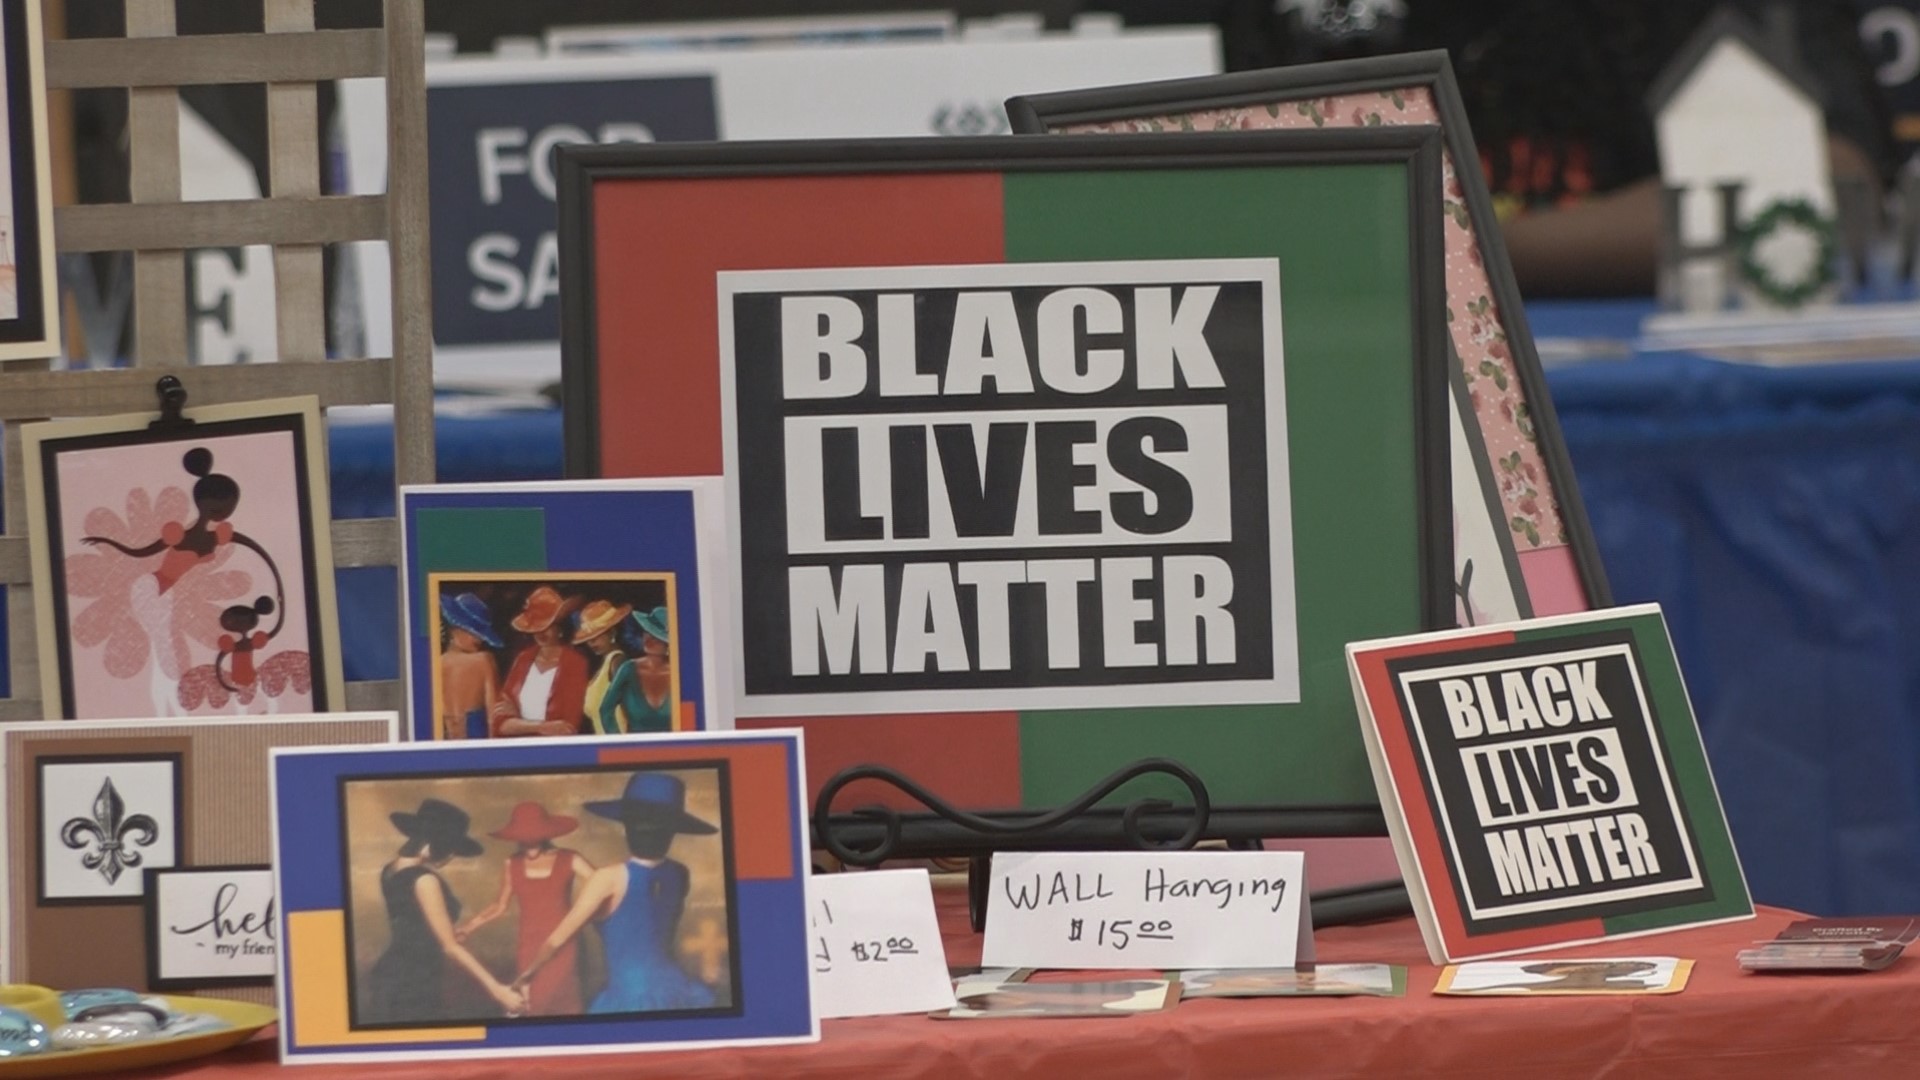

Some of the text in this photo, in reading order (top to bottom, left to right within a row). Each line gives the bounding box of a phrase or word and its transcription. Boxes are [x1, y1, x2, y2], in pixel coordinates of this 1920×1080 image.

[780, 285, 1227, 399] BLACK
[820, 416, 1194, 542] LIVES
[788, 555, 1236, 676] MATTER
[1439, 660, 1613, 739] BLACK
[1474, 736, 1620, 818] LIVES
[1005, 868, 1286, 912] WALL Hanging
[1484, 812, 1660, 896] MATTER
[171, 882, 276, 940] hel
[215, 937, 276, 959] my frien
